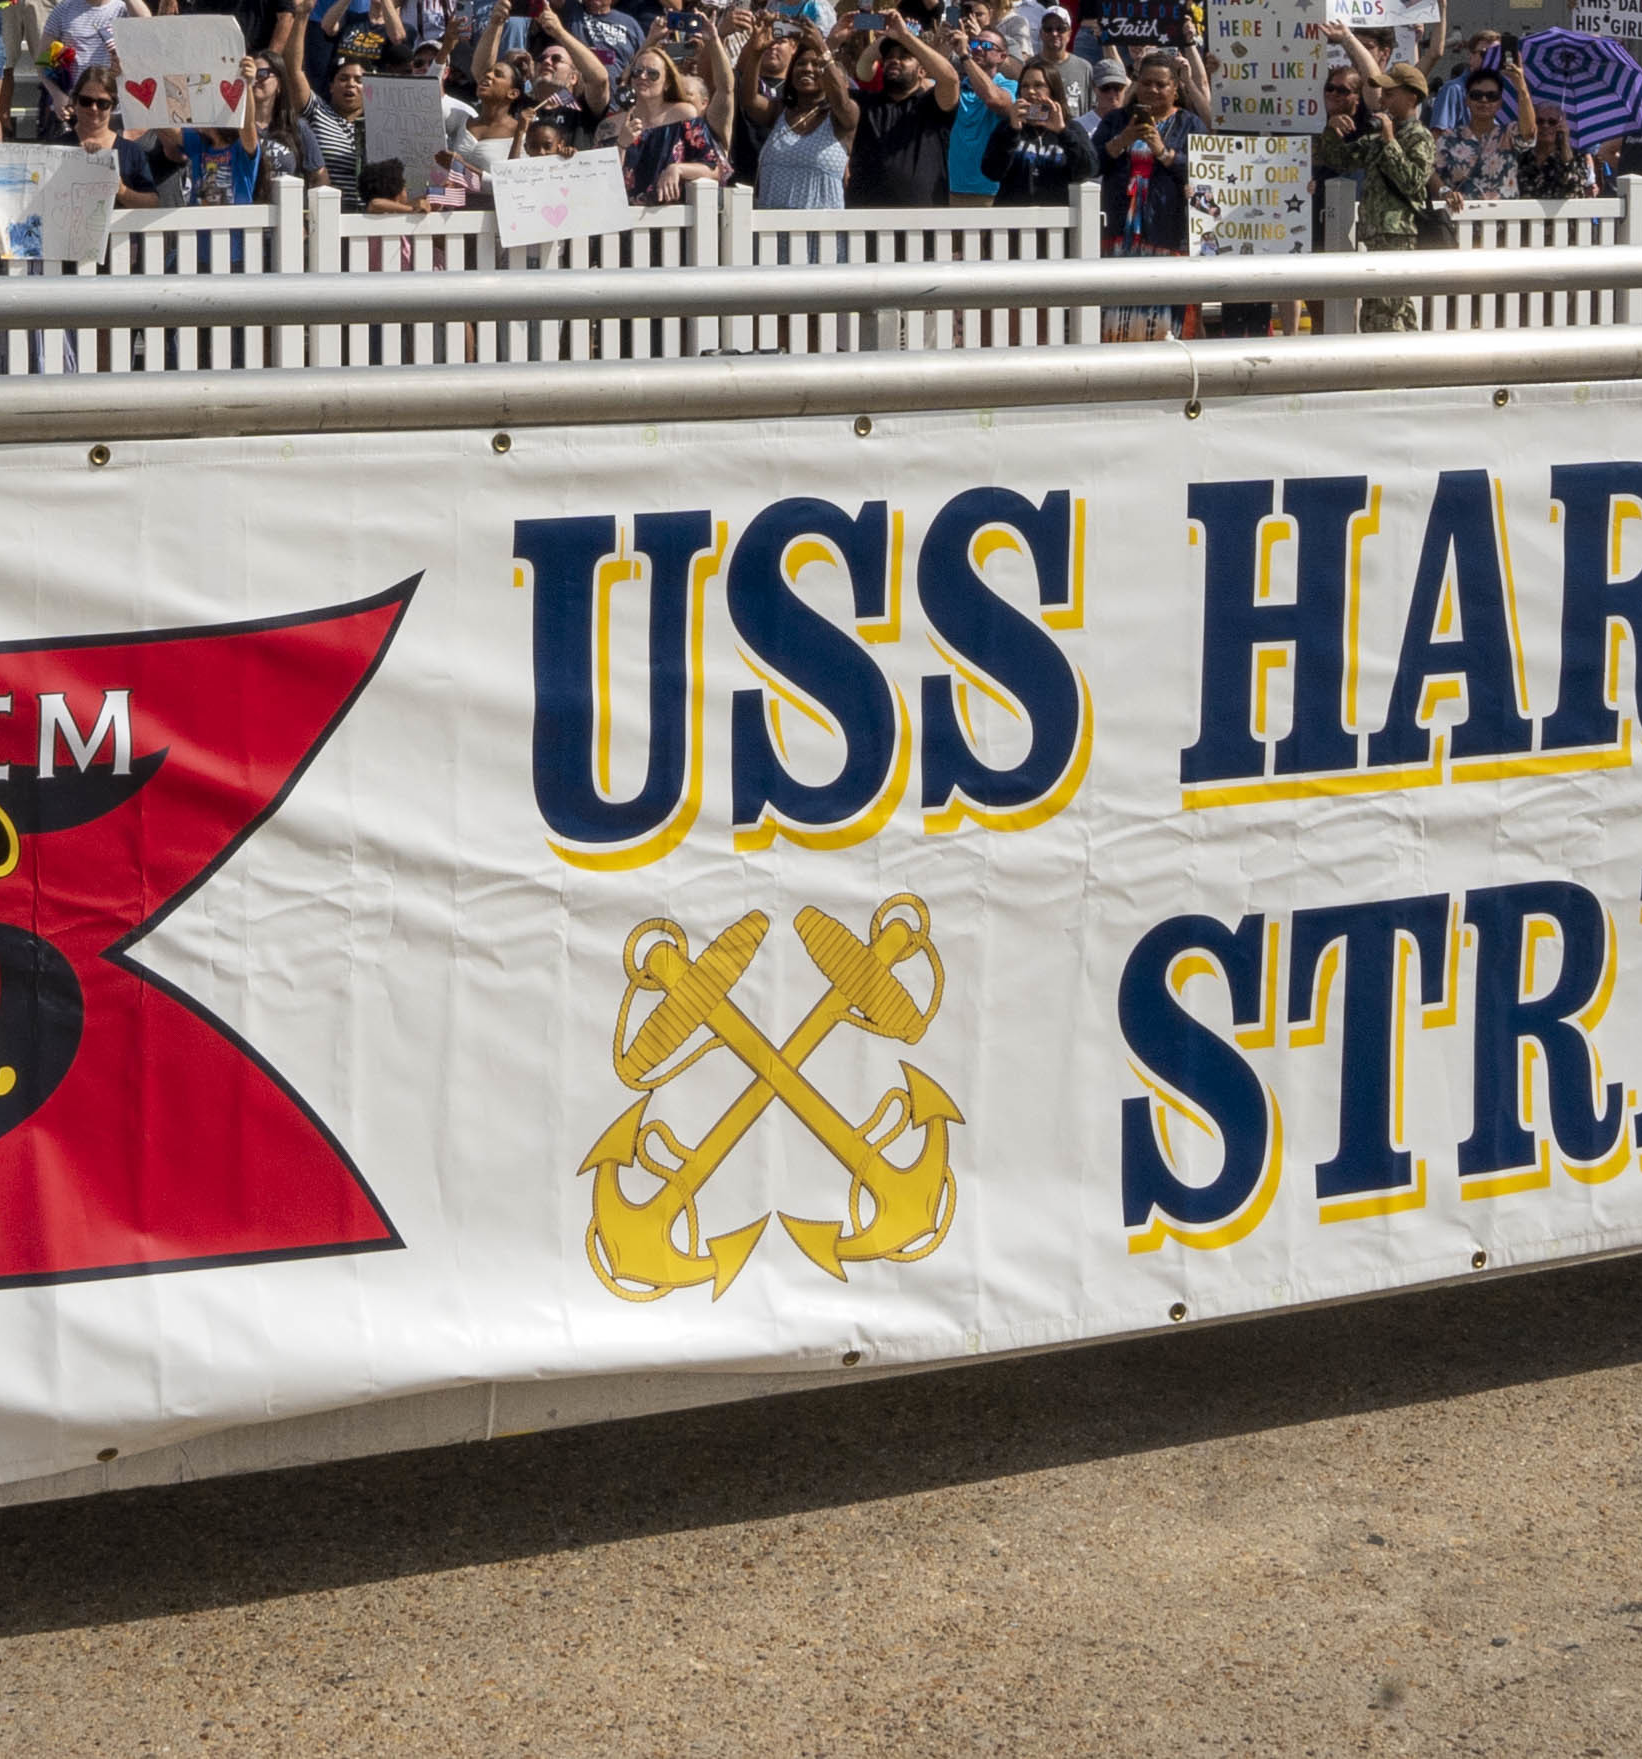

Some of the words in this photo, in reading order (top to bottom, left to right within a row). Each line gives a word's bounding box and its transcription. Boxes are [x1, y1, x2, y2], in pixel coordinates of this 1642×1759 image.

[1334, 0, 1385, 16] MADS
[1107, 17, 1160, 37] Faith
[1219, 20, 1262, 37] HERE
[1276, 20, 1281, 37] I
[1294, 22, 1319, 39] AM
[1575, 15, 1601, 32] HIS
[1222, 62, 1258, 79] JUST
[1271, 62, 1304, 79] LIKE
[1311, 63, 1317, 79] I
[1190, 136, 1234, 154] MOVE
[1244, 136, 1257, 154] IT
[1265, 136, 1288, 154] OR
[1189, 162, 1225, 180] LOSE
[1239, 165, 1254, 181] IT
[1265, 166, 1299, 183] OUR
[1217, 188, 1280, 206] AUNTIE
[1190, 217, 1203, 235] IS
[1215, 221, 1287, 240] COMING
[512, 486, 1094, 872] USS
